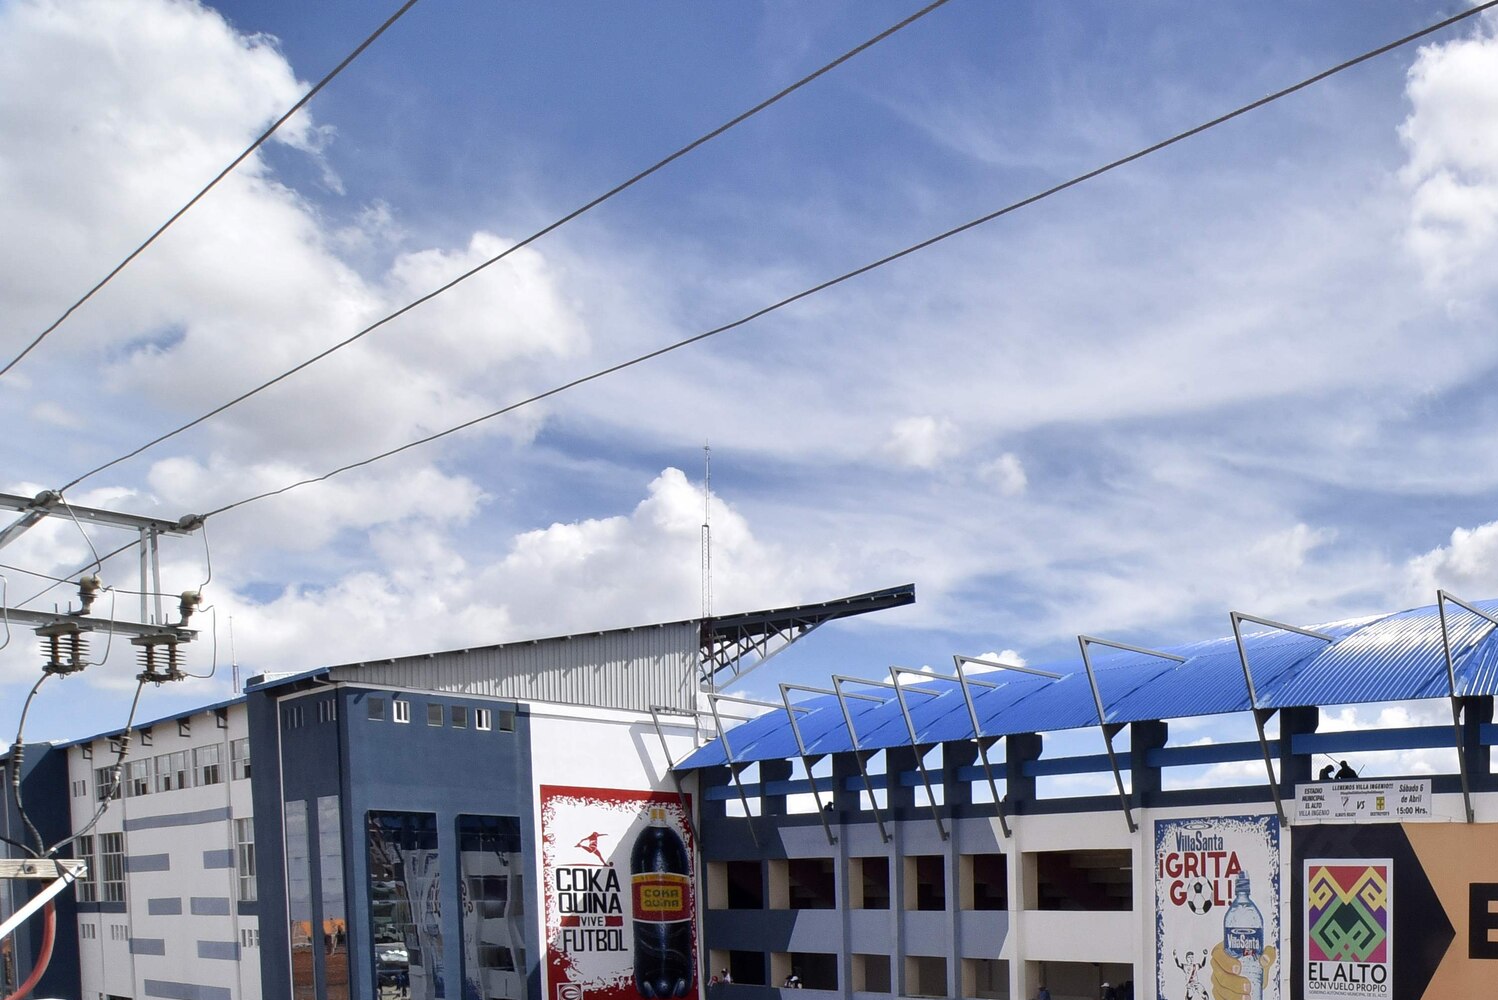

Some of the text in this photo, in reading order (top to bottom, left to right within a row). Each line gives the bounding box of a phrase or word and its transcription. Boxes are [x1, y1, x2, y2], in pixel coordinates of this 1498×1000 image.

[1409, 795, 1422, 803] Abril
[1396, 806, 1413, 814] 15:00
[1176, 831, 1223, 852] VillaSanta
[556, 867, 621, 892] COKA
[558, 893, 623, 914] QUINA
[580, 916, 604, 927] VIVE
[563, 929, 628, 952] FUTBOL
[1308, 962, 1387, 984] EL ALTO
[1309, 981, 1387, 993] CON VUELO PROPIO
